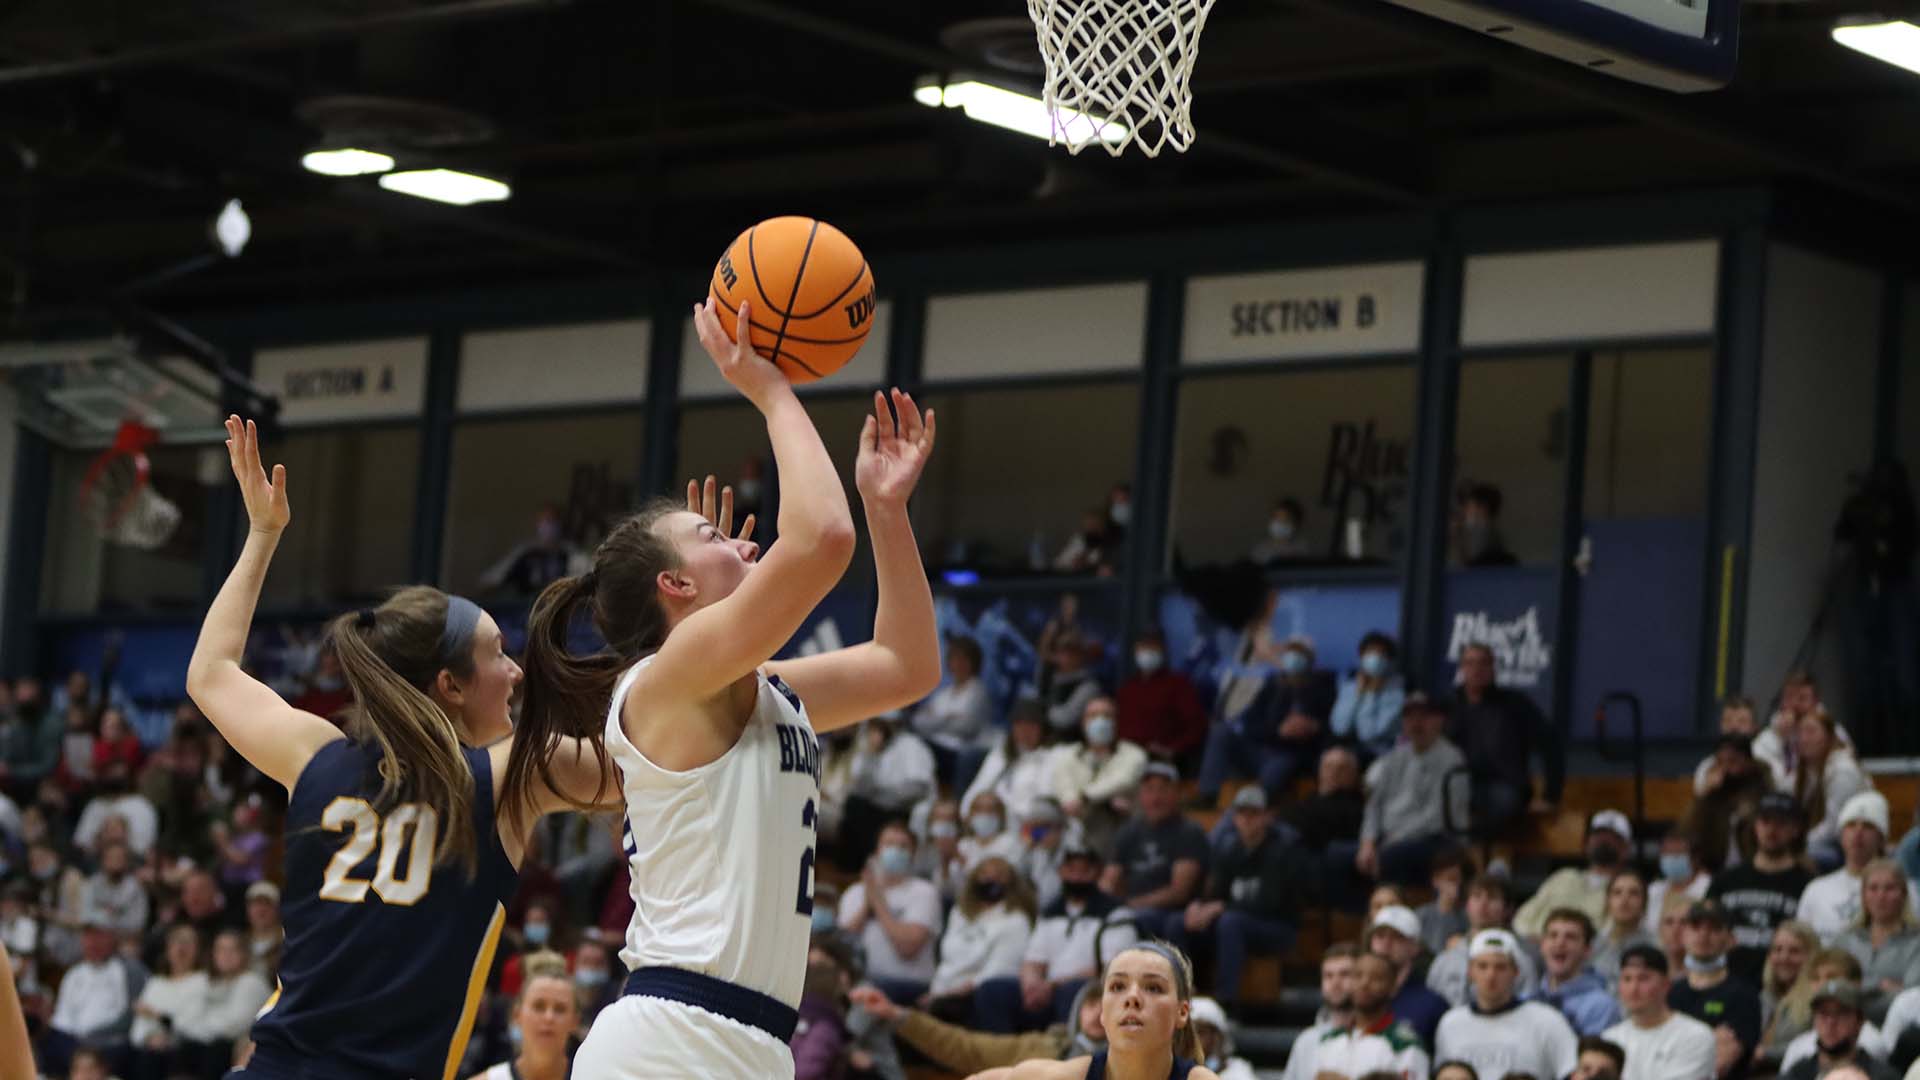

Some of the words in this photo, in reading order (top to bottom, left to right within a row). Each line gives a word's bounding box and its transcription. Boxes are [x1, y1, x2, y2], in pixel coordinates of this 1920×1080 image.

[1231, 301, 1341, 335] SECTION
[1356, 295, 1377, 327] B
[319, 796, 439, 906] 20
